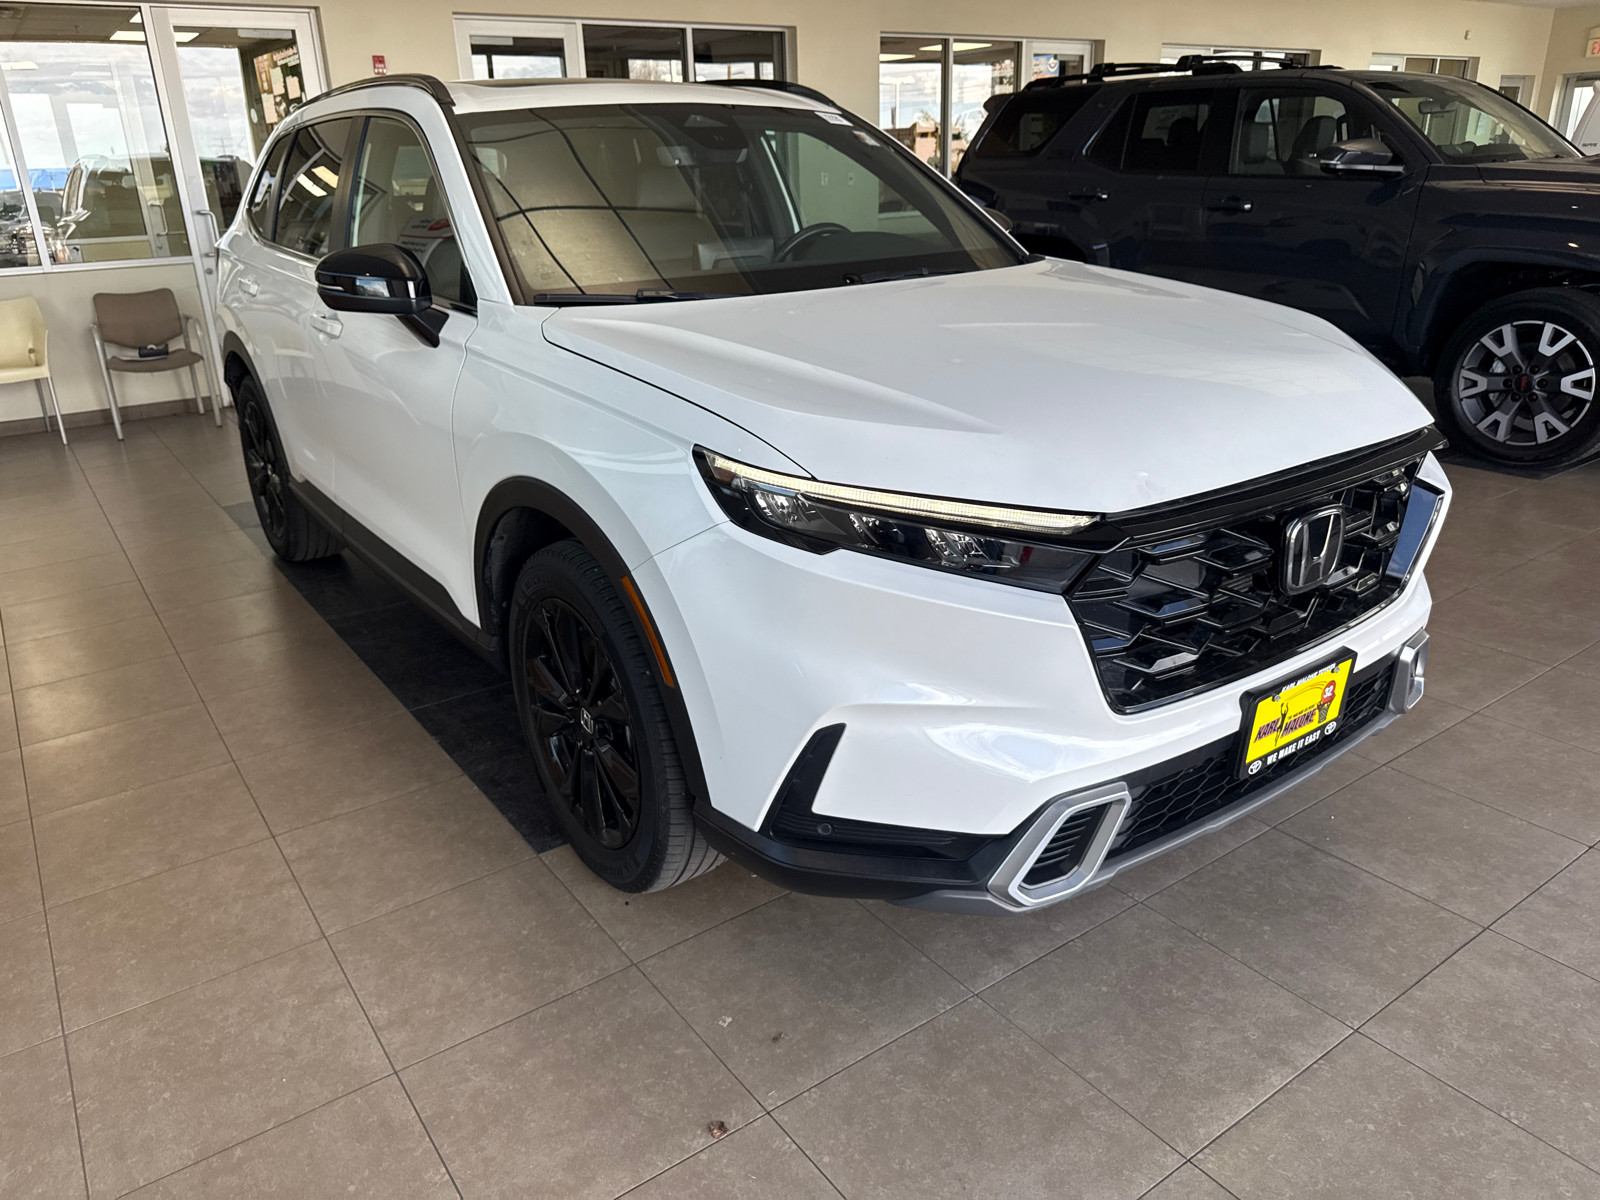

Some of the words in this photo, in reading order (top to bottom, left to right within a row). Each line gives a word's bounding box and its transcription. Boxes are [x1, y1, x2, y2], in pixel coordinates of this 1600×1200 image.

[1323, 685, 1334, 698] 32
[1253, 717, 1281, 743] KARL
[1280, 708, 1317, 739] MALONE
[1267, 752, 1278, 765] WE
[1278, 742, 1297, 760] MAKE
[1297, 738, 1305, 750] IT
